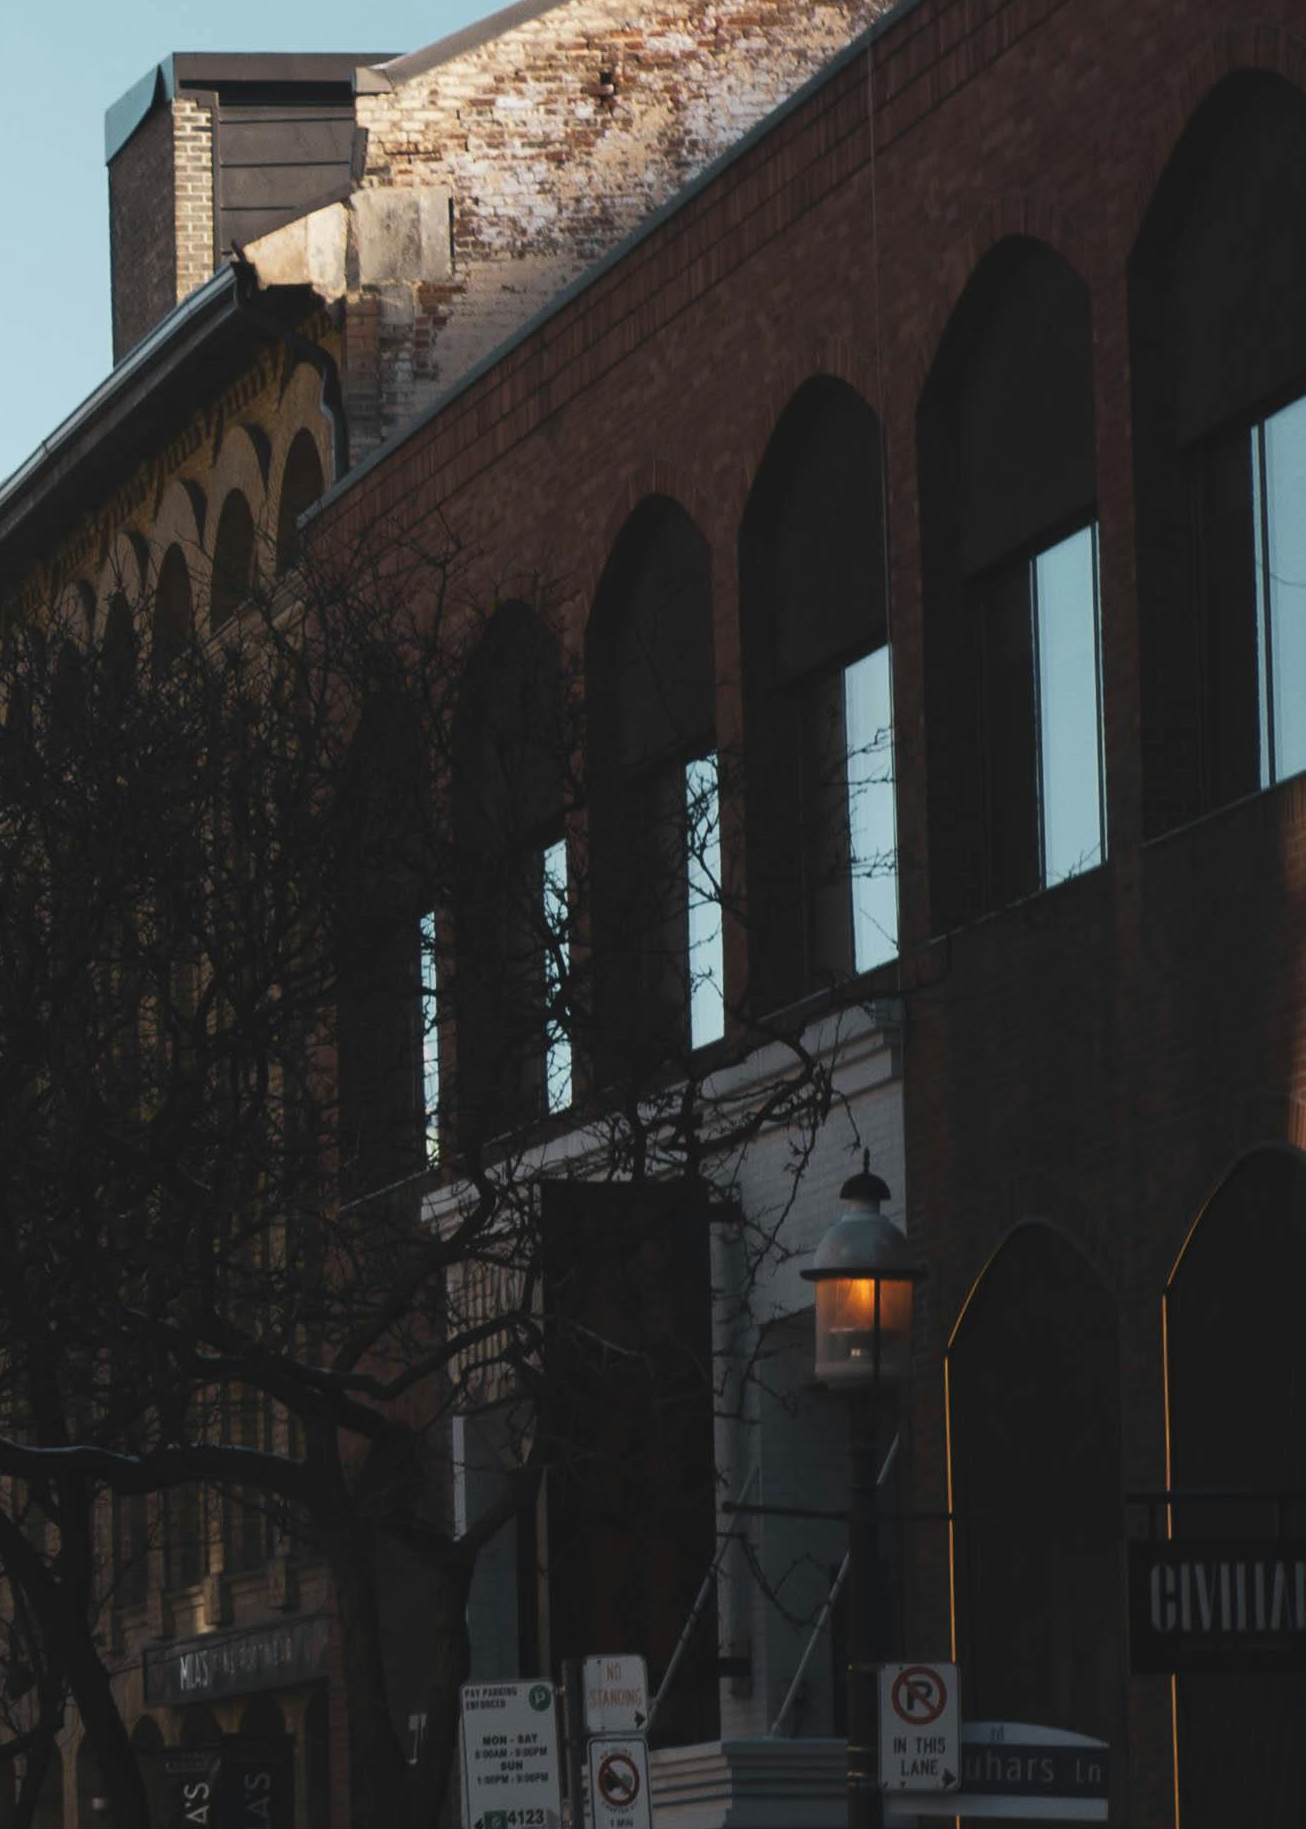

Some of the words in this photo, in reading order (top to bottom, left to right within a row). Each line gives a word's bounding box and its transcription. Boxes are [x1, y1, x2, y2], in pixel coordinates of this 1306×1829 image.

[606, 1662, 621, 1682] NO
[589, 1689, 642, 1708] STANDING
[482, 1735, 507, 1746] MON
[893, 1738, 907, 1754] IN
[915, 1737, 946, 1754] THIS
[500, 1760, 524, 1771] SUN
[901, 1759, 939, 1777] LANE
[1075, 1756, 1101, 1784] Ln
[507, 1809, 545, 1826] 4123
